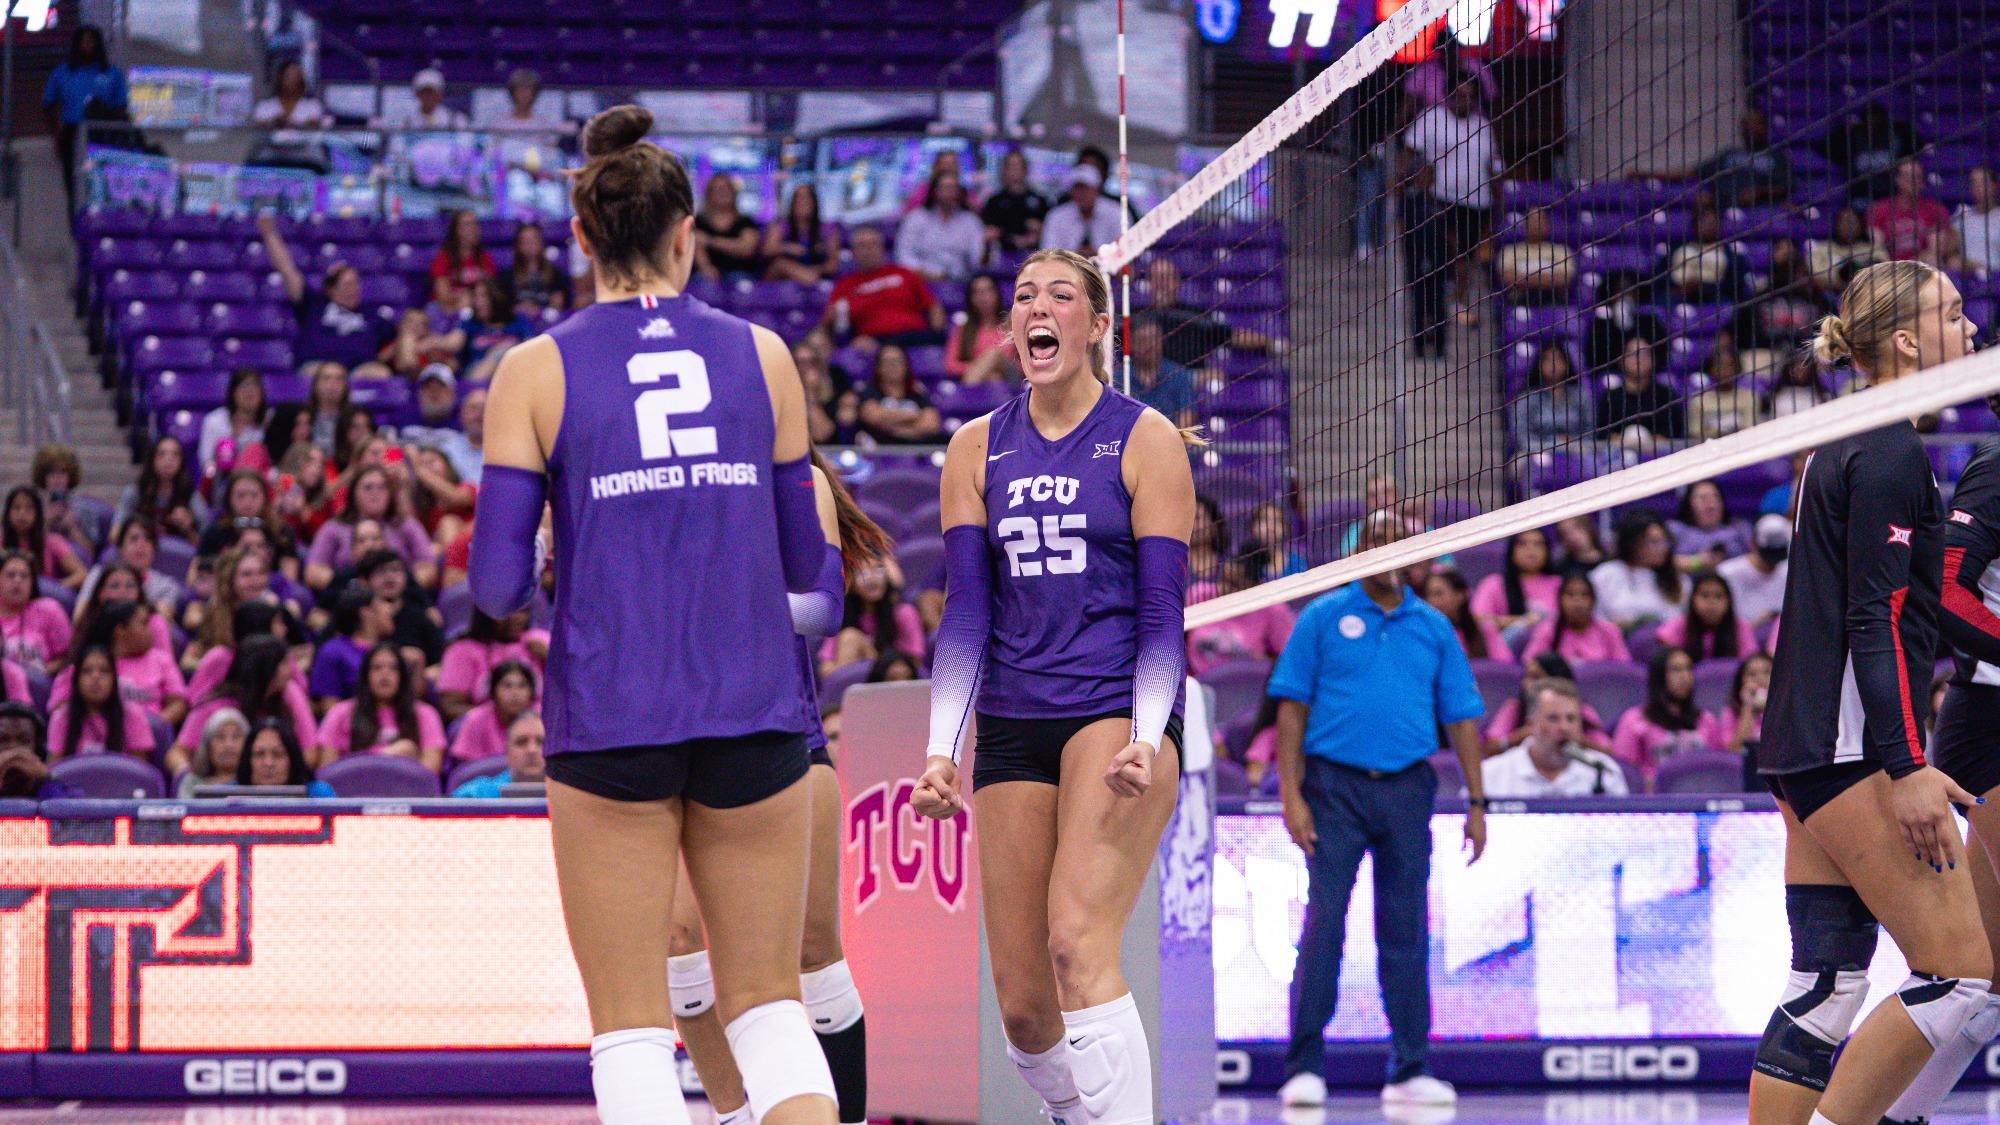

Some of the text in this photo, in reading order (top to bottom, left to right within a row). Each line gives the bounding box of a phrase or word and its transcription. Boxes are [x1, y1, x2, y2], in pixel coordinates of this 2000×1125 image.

[626, 349, 719, 461] 2
[590, 462, 757, 500] HORNED FROGS
[1006, 474, 1080, 509] TCU
[997, 513, 1087, 577] 25
[846, 777, 973, 915] TCU
[183, 1058, 348, 1095] GEICO
[1542, 1045, 1700, 1080] GEICO
